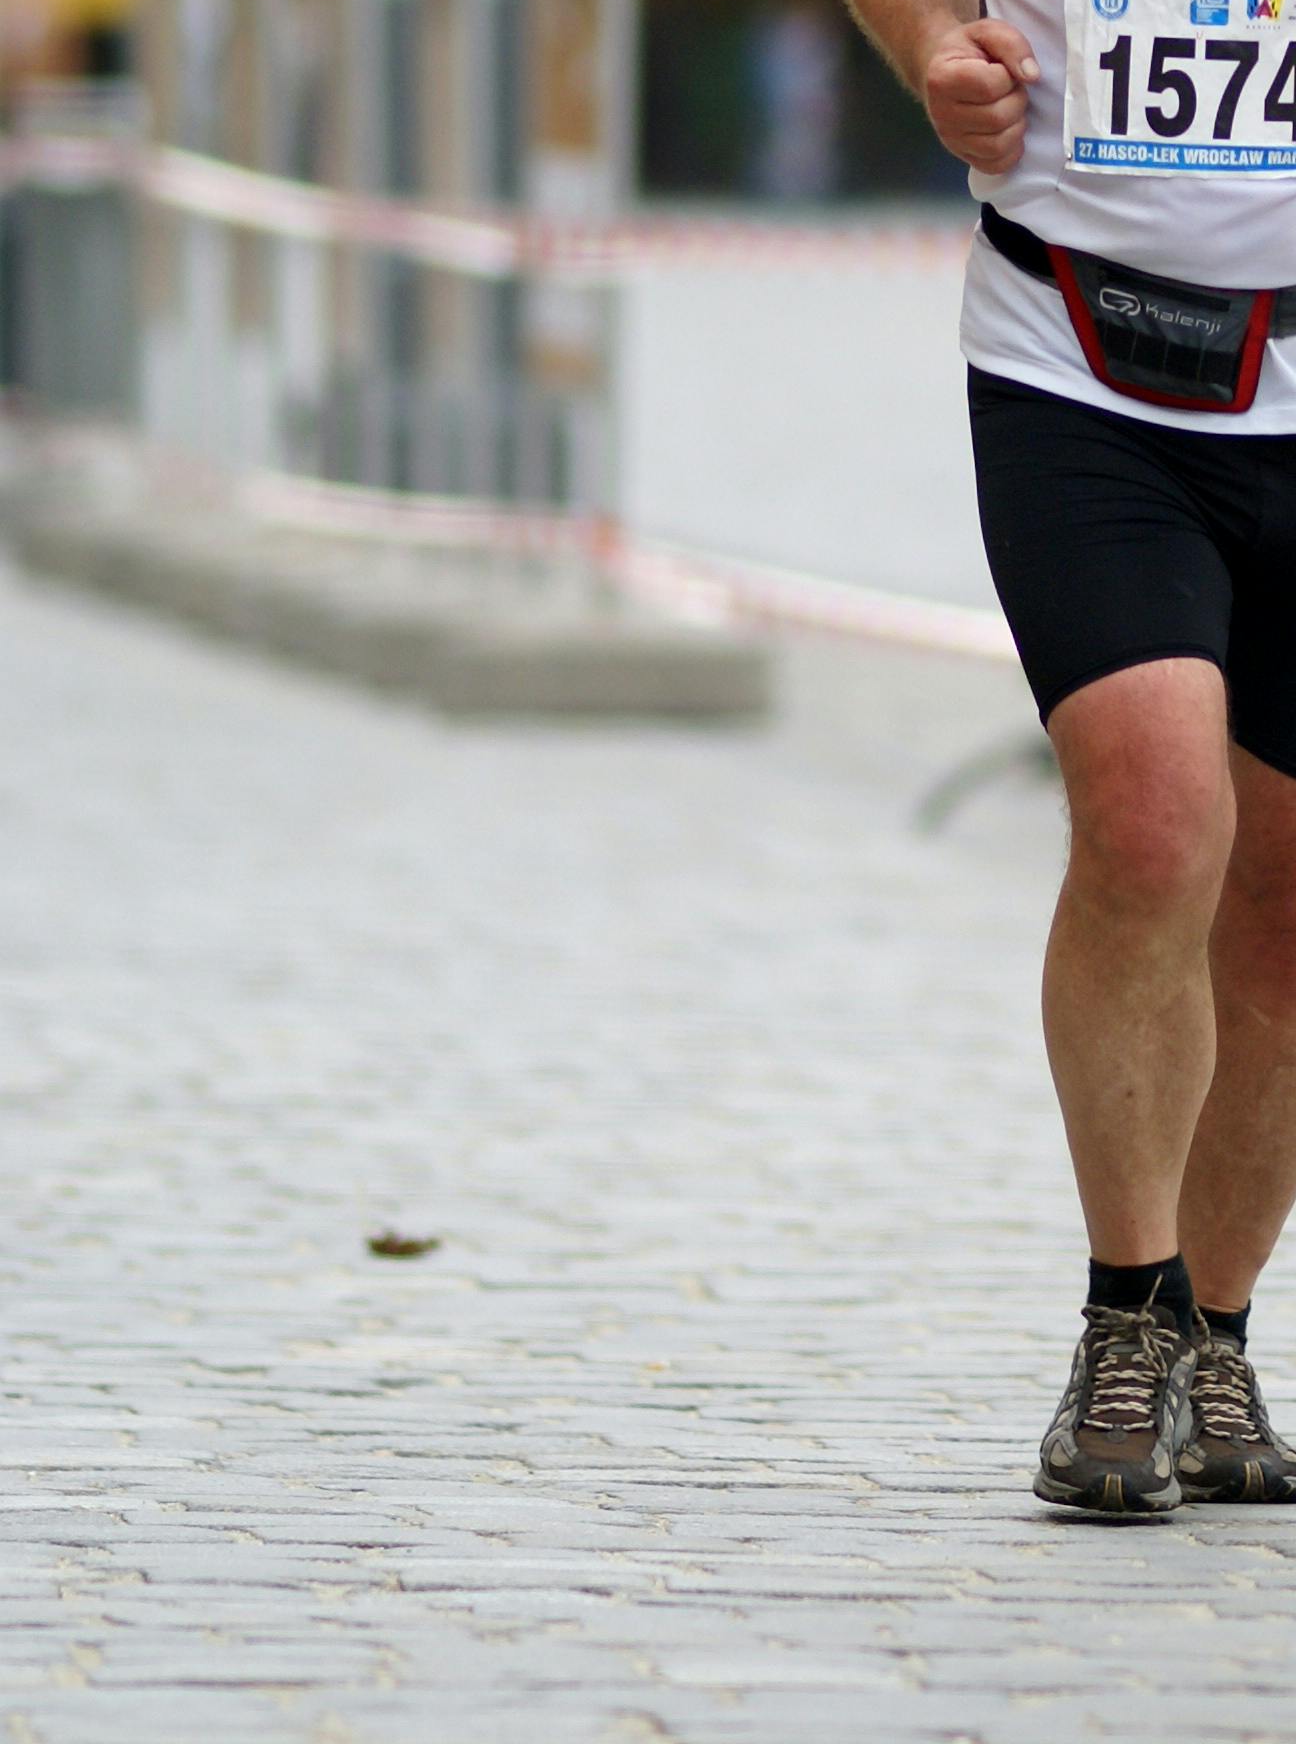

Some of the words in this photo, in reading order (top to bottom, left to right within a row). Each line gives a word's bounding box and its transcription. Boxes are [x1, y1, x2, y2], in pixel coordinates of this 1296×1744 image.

[1079, 142, 1096, 158] 27.
[1098, 144, 1179, 163] HASCO-LEK
[1145, 303, 1223, 336] Kalenji
